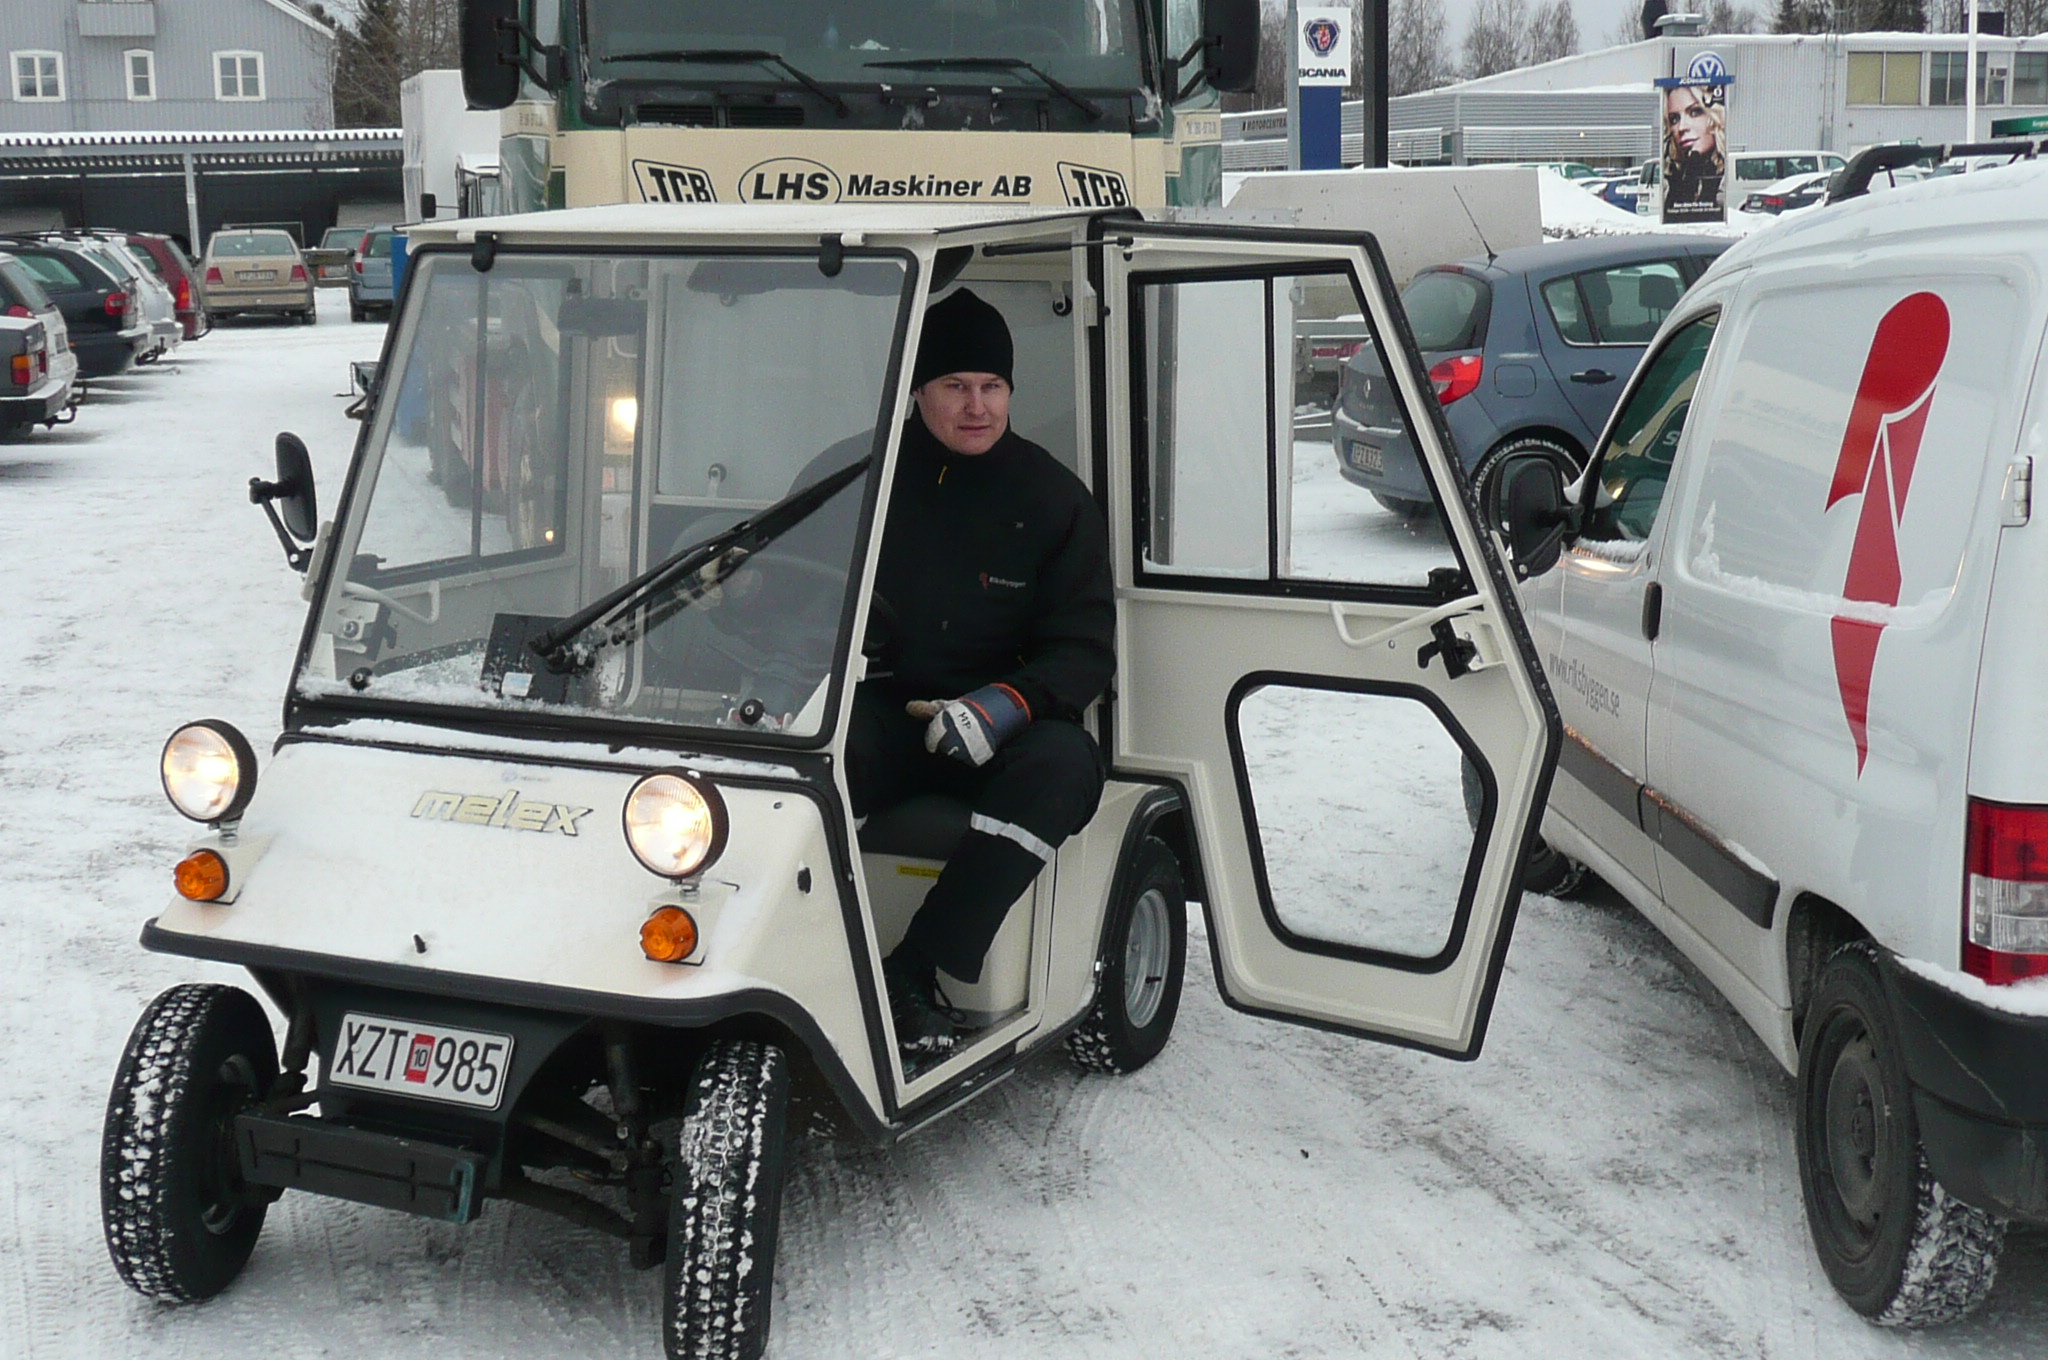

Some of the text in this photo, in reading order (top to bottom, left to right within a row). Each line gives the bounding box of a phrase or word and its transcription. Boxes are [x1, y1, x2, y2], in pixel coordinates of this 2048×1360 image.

[1299, 68, 1346, 78] SCANIA
[648, 167, 711, 203] JCB
[753, 172, 1032, 200] LHS Maskiner AB
[1071, 169, 1126, 206] JCB
[411, 789, 594, 837] melex
[336, 1021, 503, 1096] XZT 10 985
